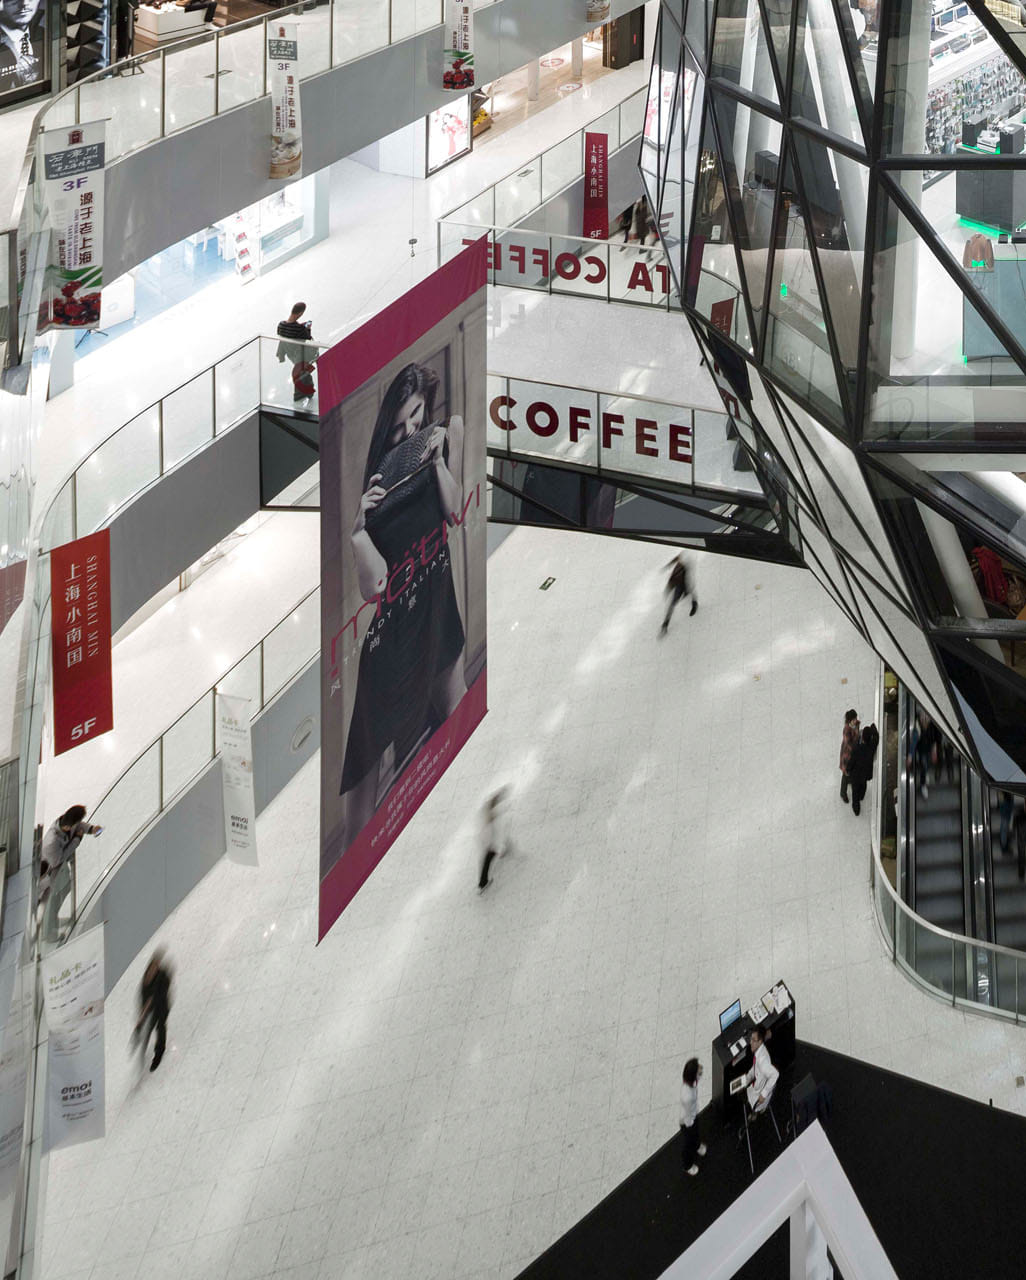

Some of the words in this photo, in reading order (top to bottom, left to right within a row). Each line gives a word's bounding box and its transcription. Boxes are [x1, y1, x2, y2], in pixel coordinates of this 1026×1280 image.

[278, 62, 290, 71] 3F
[63, 176, 88, 192] 3F
[590, 229, 602, 239] 5F
[489, 395, 692, 464] COFFEE
[87, 554, 98, 626] SHANGHAI
[64, 563, 83, 668] 上海小南国
[87, 631, 99, 657] MIN
[70, 717, 97, 740] 5F
